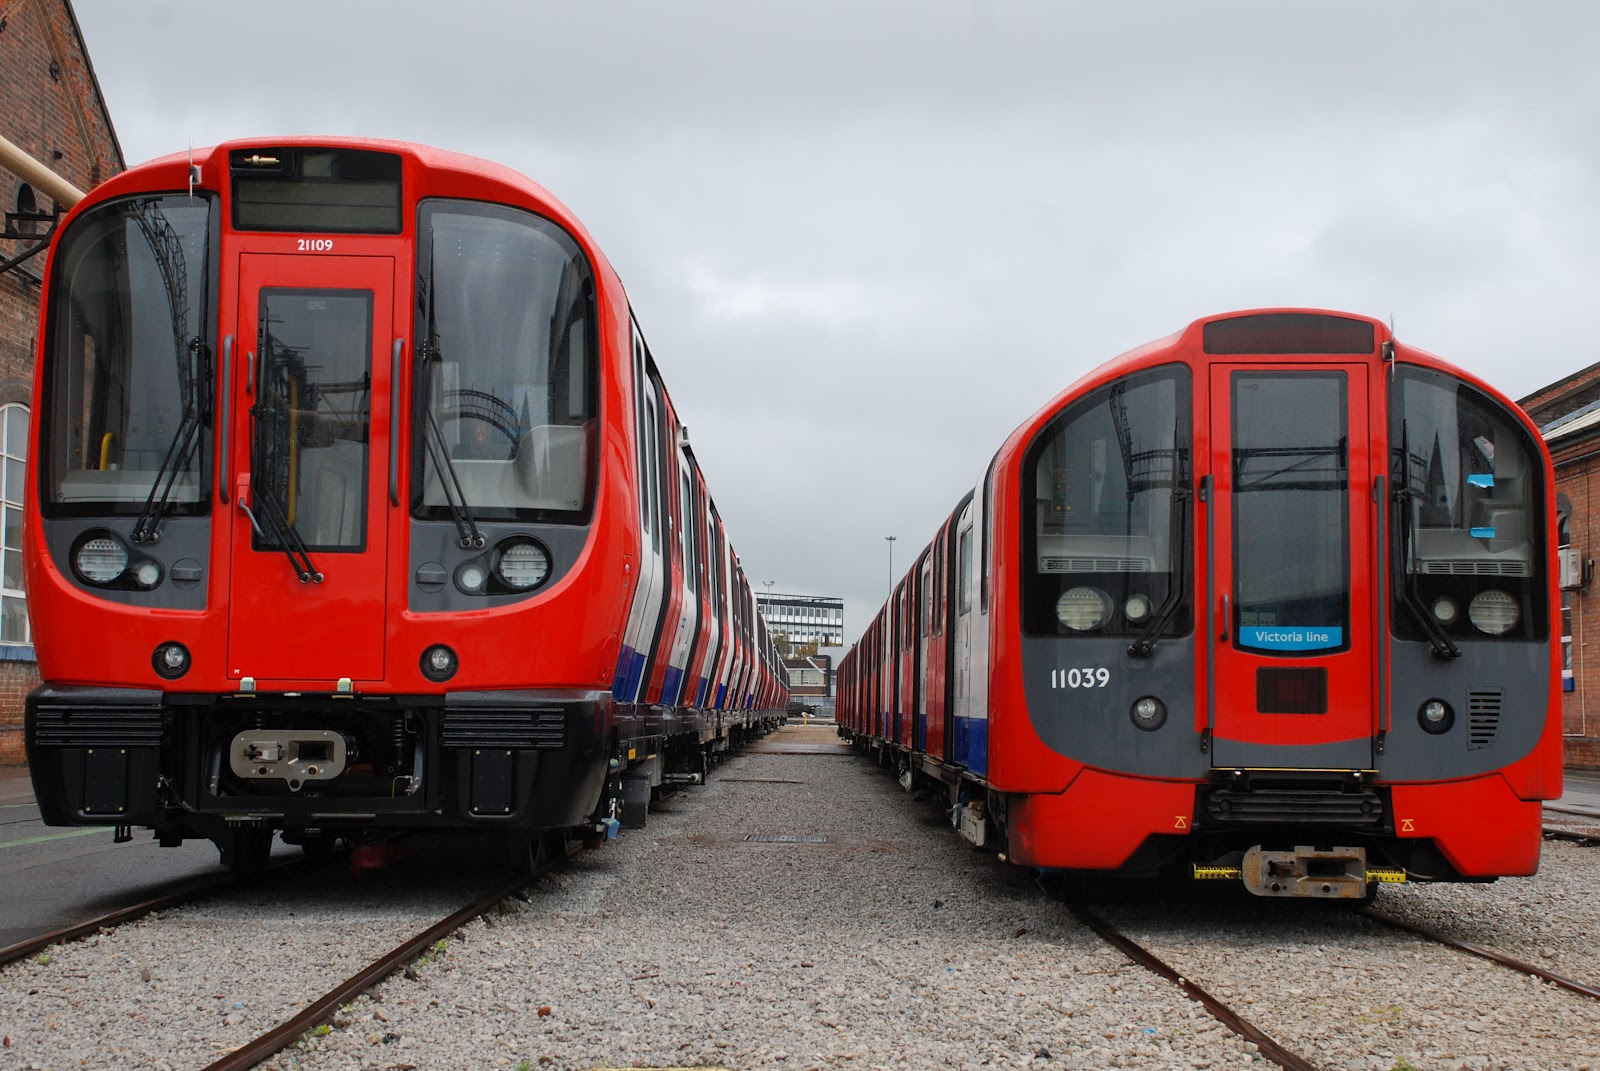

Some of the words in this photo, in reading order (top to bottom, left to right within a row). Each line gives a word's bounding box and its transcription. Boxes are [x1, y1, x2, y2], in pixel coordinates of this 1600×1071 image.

[297, 239, 333, 251] 21109
[1255, 631, 1303, 642] Victoria
[1306, 631, 1329, 642] line
[1051, 667, 1110, 689] 11039
